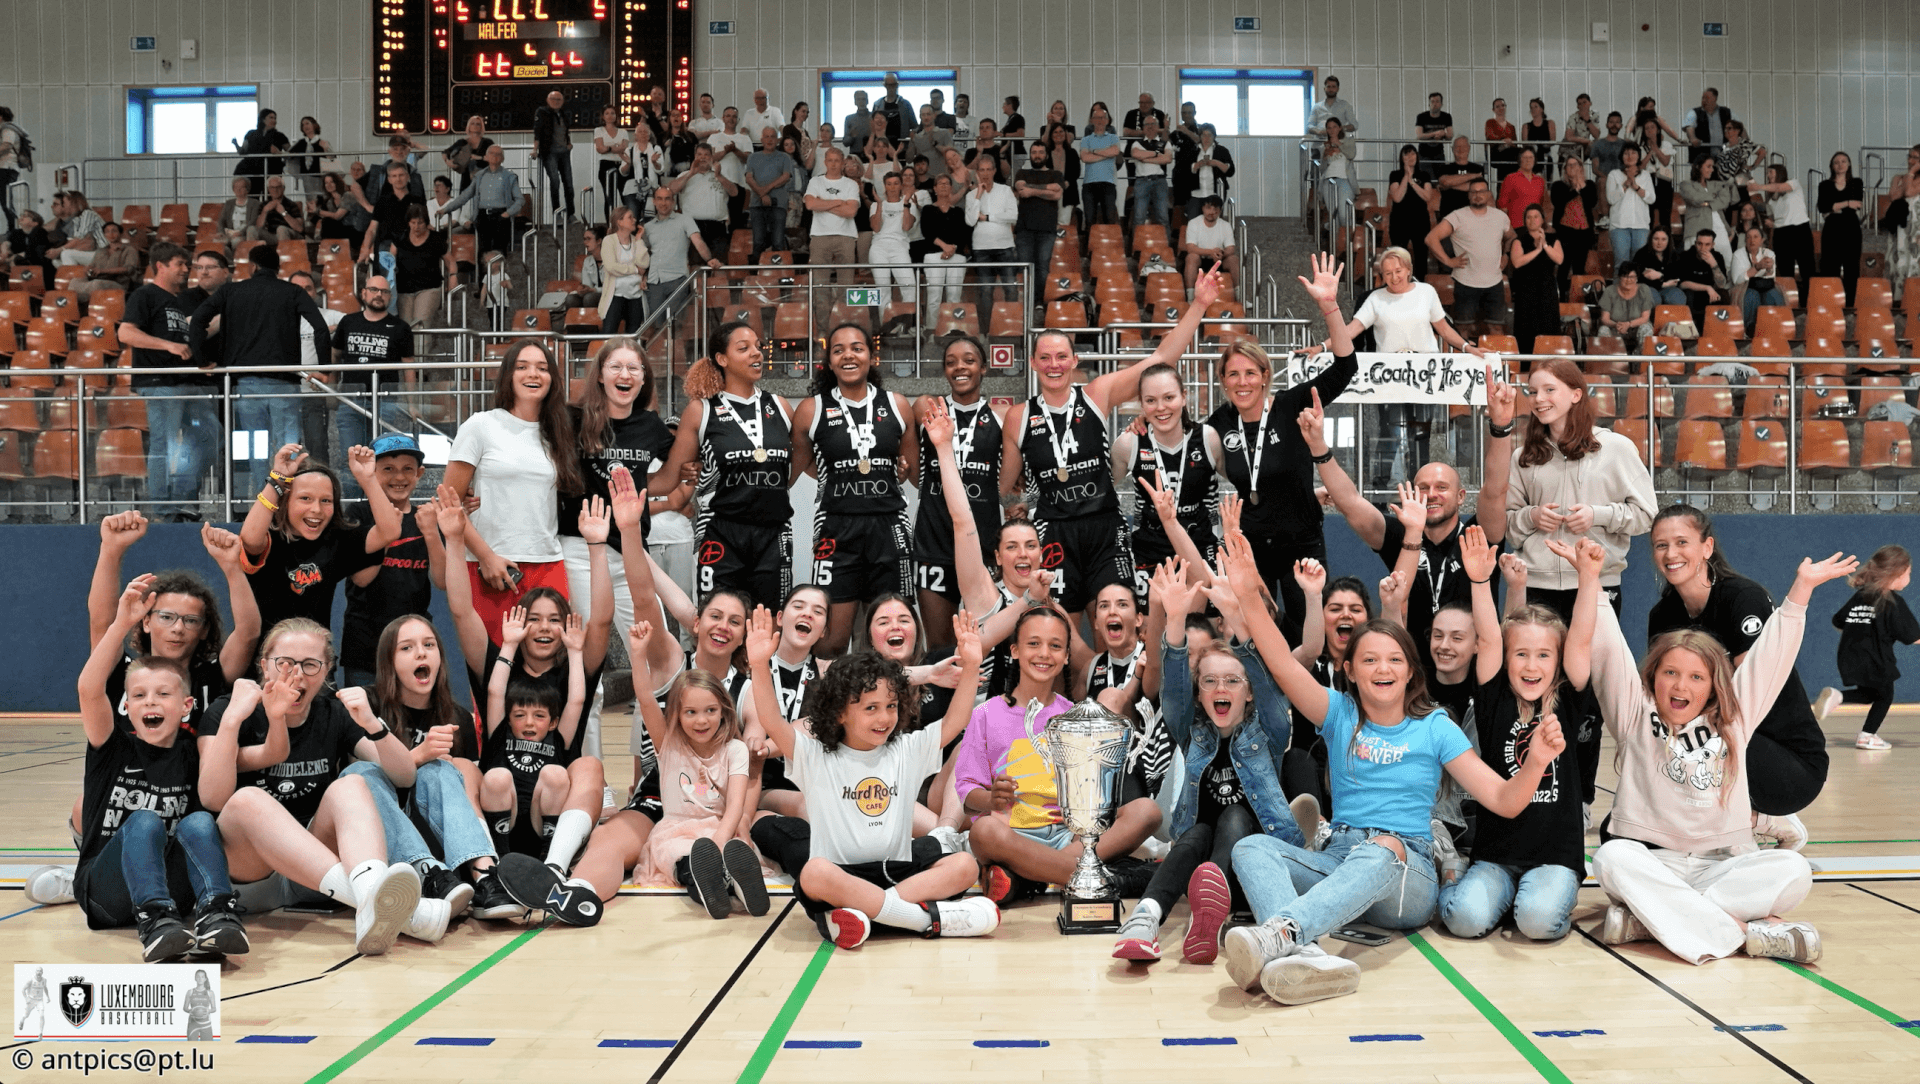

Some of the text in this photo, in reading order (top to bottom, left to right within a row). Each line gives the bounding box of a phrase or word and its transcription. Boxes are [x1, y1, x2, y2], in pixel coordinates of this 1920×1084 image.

[478, 22, 518, 40] WALFER
[347, 335, 389, 348] ROLLING
[1369, 361, 1420, 390] Coach
[1418, 358, 1437, 395] of
[1438, 357, 1463, 393] the
[1462, 367, 1502, 405] yer
[724, 448, 788, 460] cruani
[701, 565, 715, 592] 9
[813, 560, 834, 586] 15
[918, 565, 947, 592] 12
[842, 785, 872, 800] Hard
